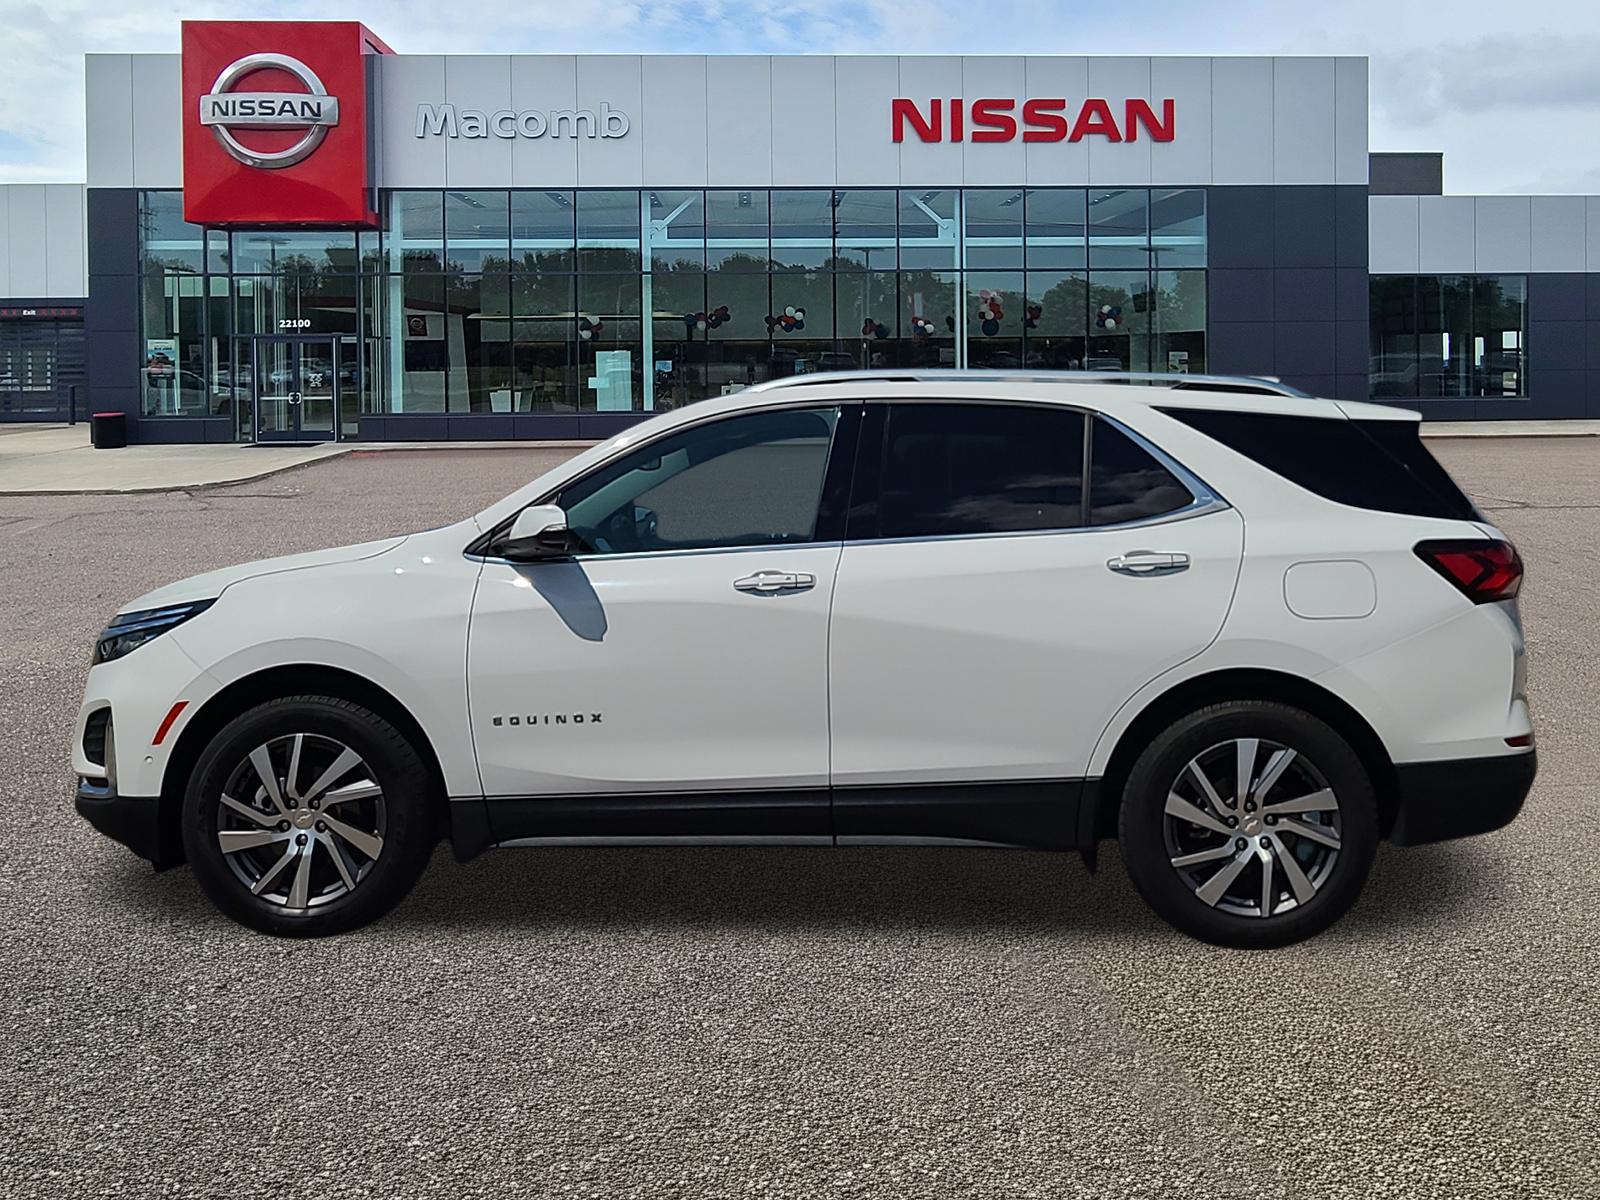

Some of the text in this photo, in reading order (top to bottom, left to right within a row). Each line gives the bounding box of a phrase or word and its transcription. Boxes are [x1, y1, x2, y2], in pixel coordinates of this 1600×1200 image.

[212, 100, 322, 118] NISSAN
[415, 102, 630, 139] Macomb
[892, 98, 1175, 143] NISSAN
[279, 319, 311, 328] 22100
[493, 713, 602, 726] EQUINOX
